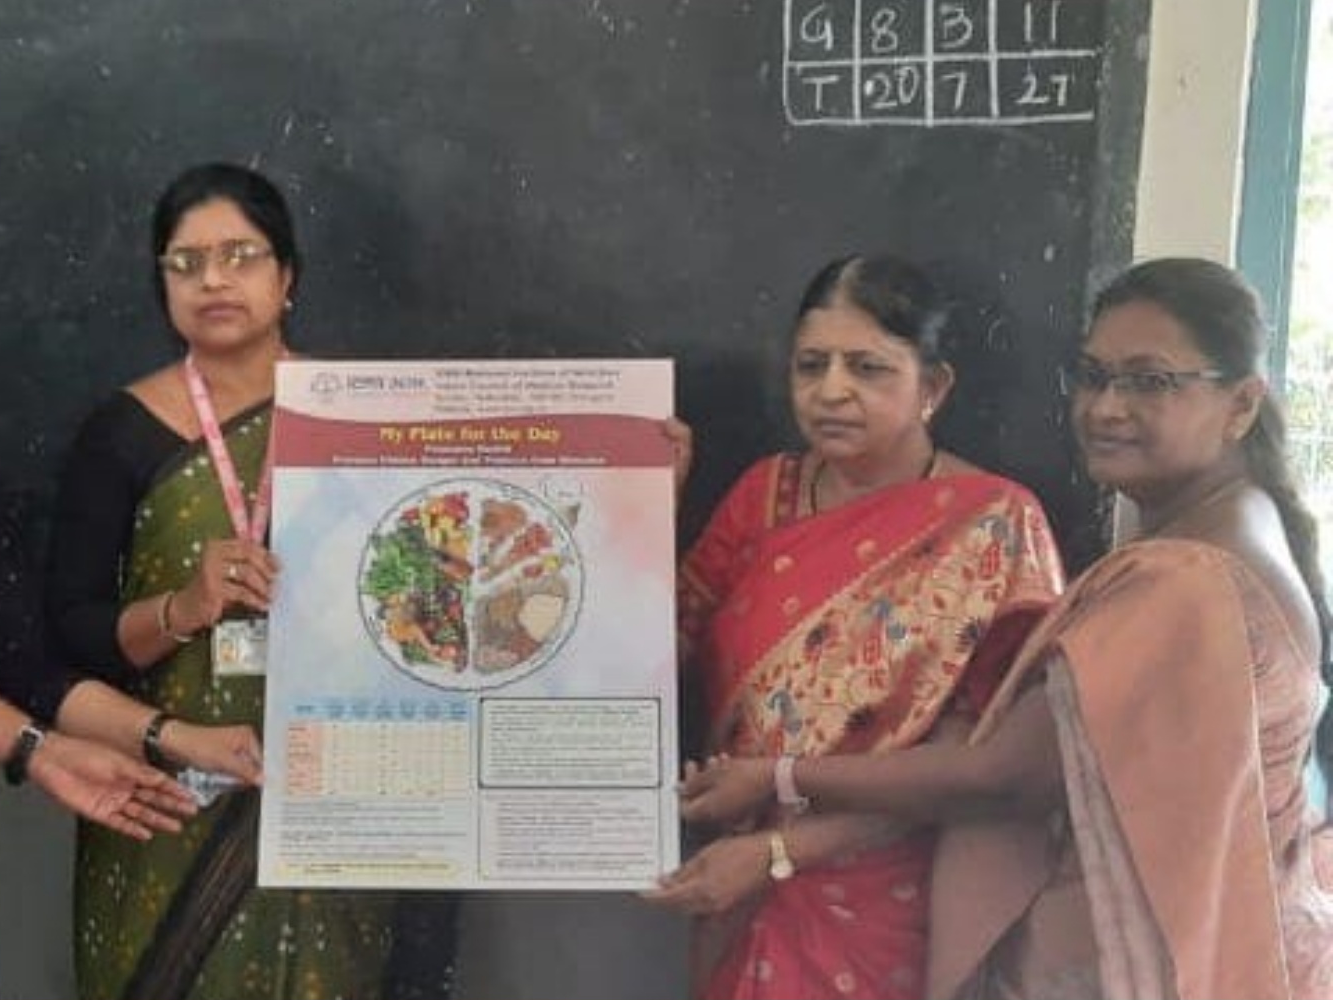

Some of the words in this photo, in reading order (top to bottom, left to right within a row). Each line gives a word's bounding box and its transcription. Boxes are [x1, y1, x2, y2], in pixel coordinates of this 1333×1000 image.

[871, 8, 898, 51] 8
[940, 5, 973, 48] 3
[802, 73, 840, 111] T
[864, 65, 921, 110] 20
[941, 71, 968, 110] 7
[1016, 72, 1068, 107] 27
[379, 427, 402, 444] My
[410, 427, 454, 441] Plate
[460, 427, 484, 441] for
[491, 427, 522, 441] the
[527, 427, 561, 443] Day
